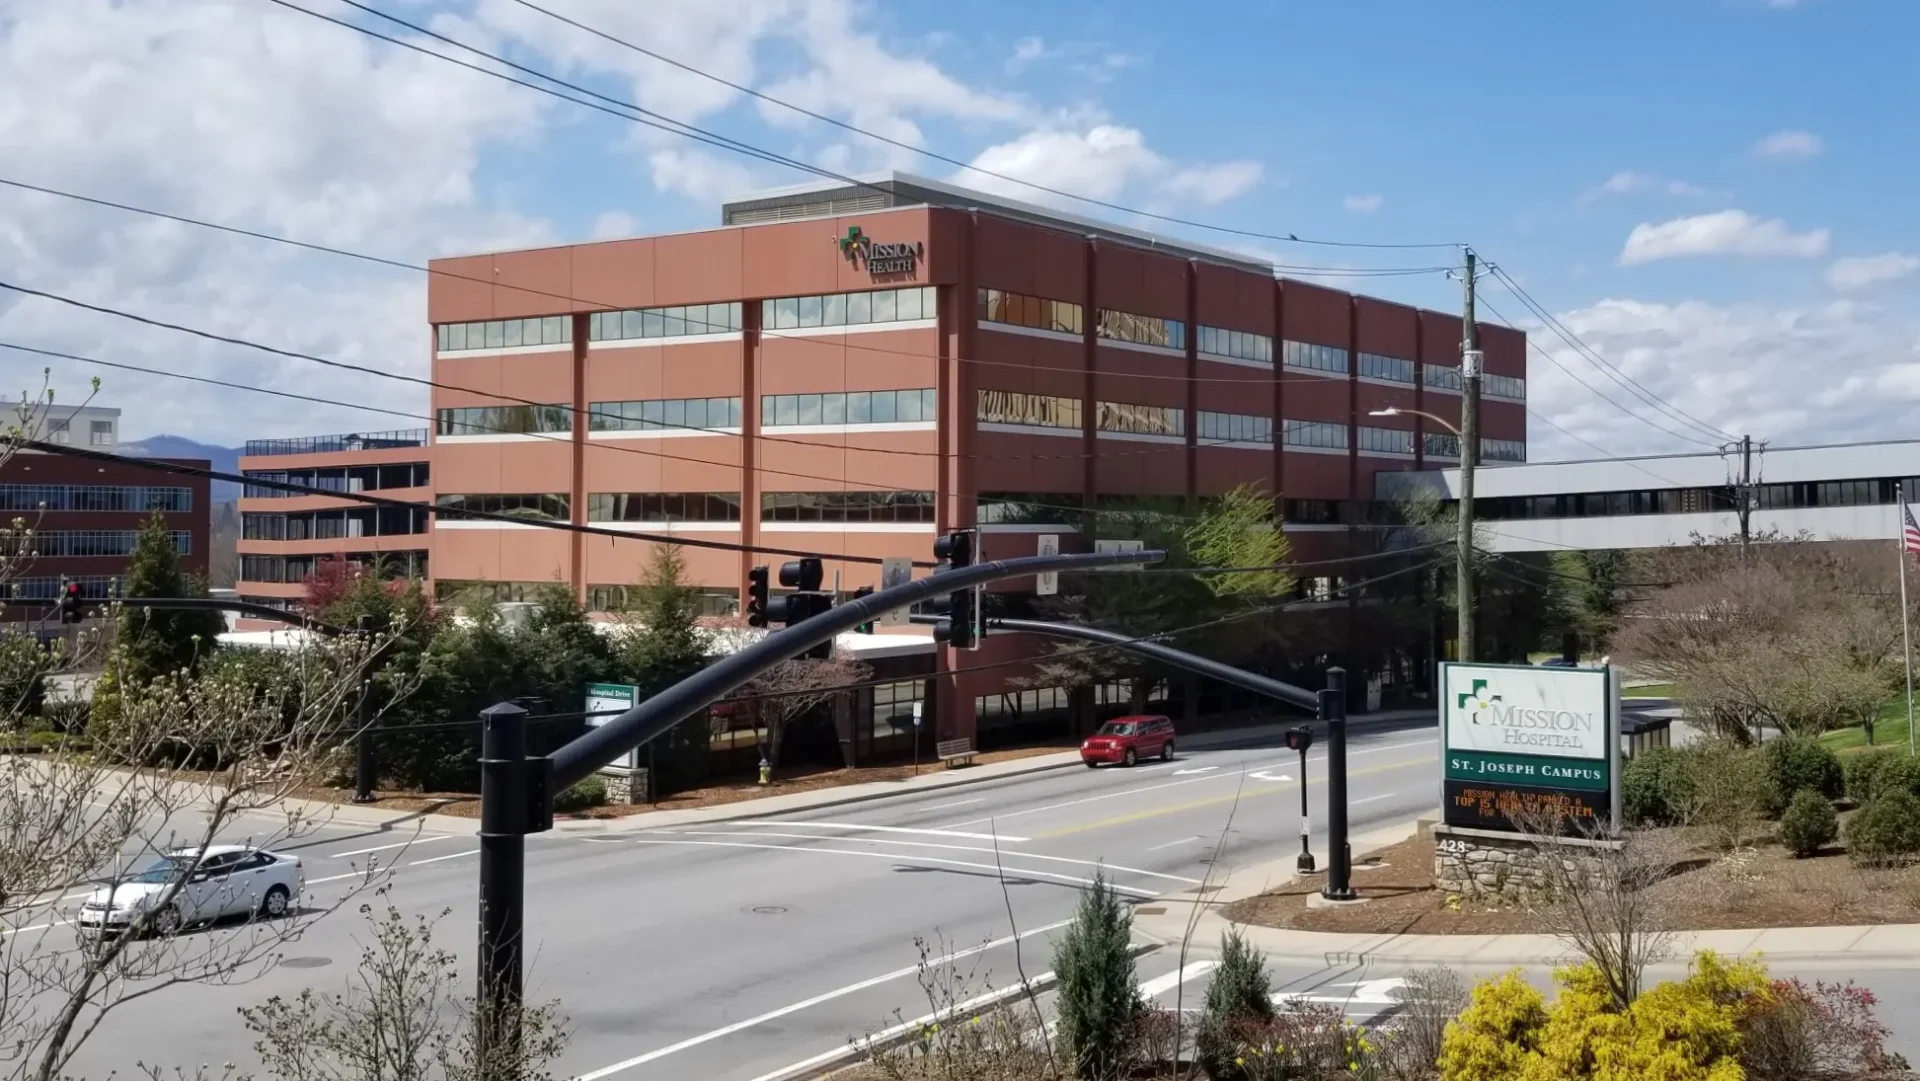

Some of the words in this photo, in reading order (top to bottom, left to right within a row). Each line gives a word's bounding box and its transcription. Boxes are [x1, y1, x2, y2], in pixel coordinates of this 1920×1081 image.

[859, 241, 919, 260] MISSION
[867, 259, 912, 273] HEALTH
[590, 688, 614, 697] Hospital
[615, 689, 631, 698] Drive
[1490, 704, 1593, 731] MISSION
[1503, 728, 1583, 748] HOSPITAL
[1451, 758, 1474, 771] ST.
[1478, 760, 1535, 775] JOSEPH
[1541, 765, 1601, 780] CAMPUS
[1454, 795, 1476, 808] TOP
[1439, 839, 1466, 853] 428
